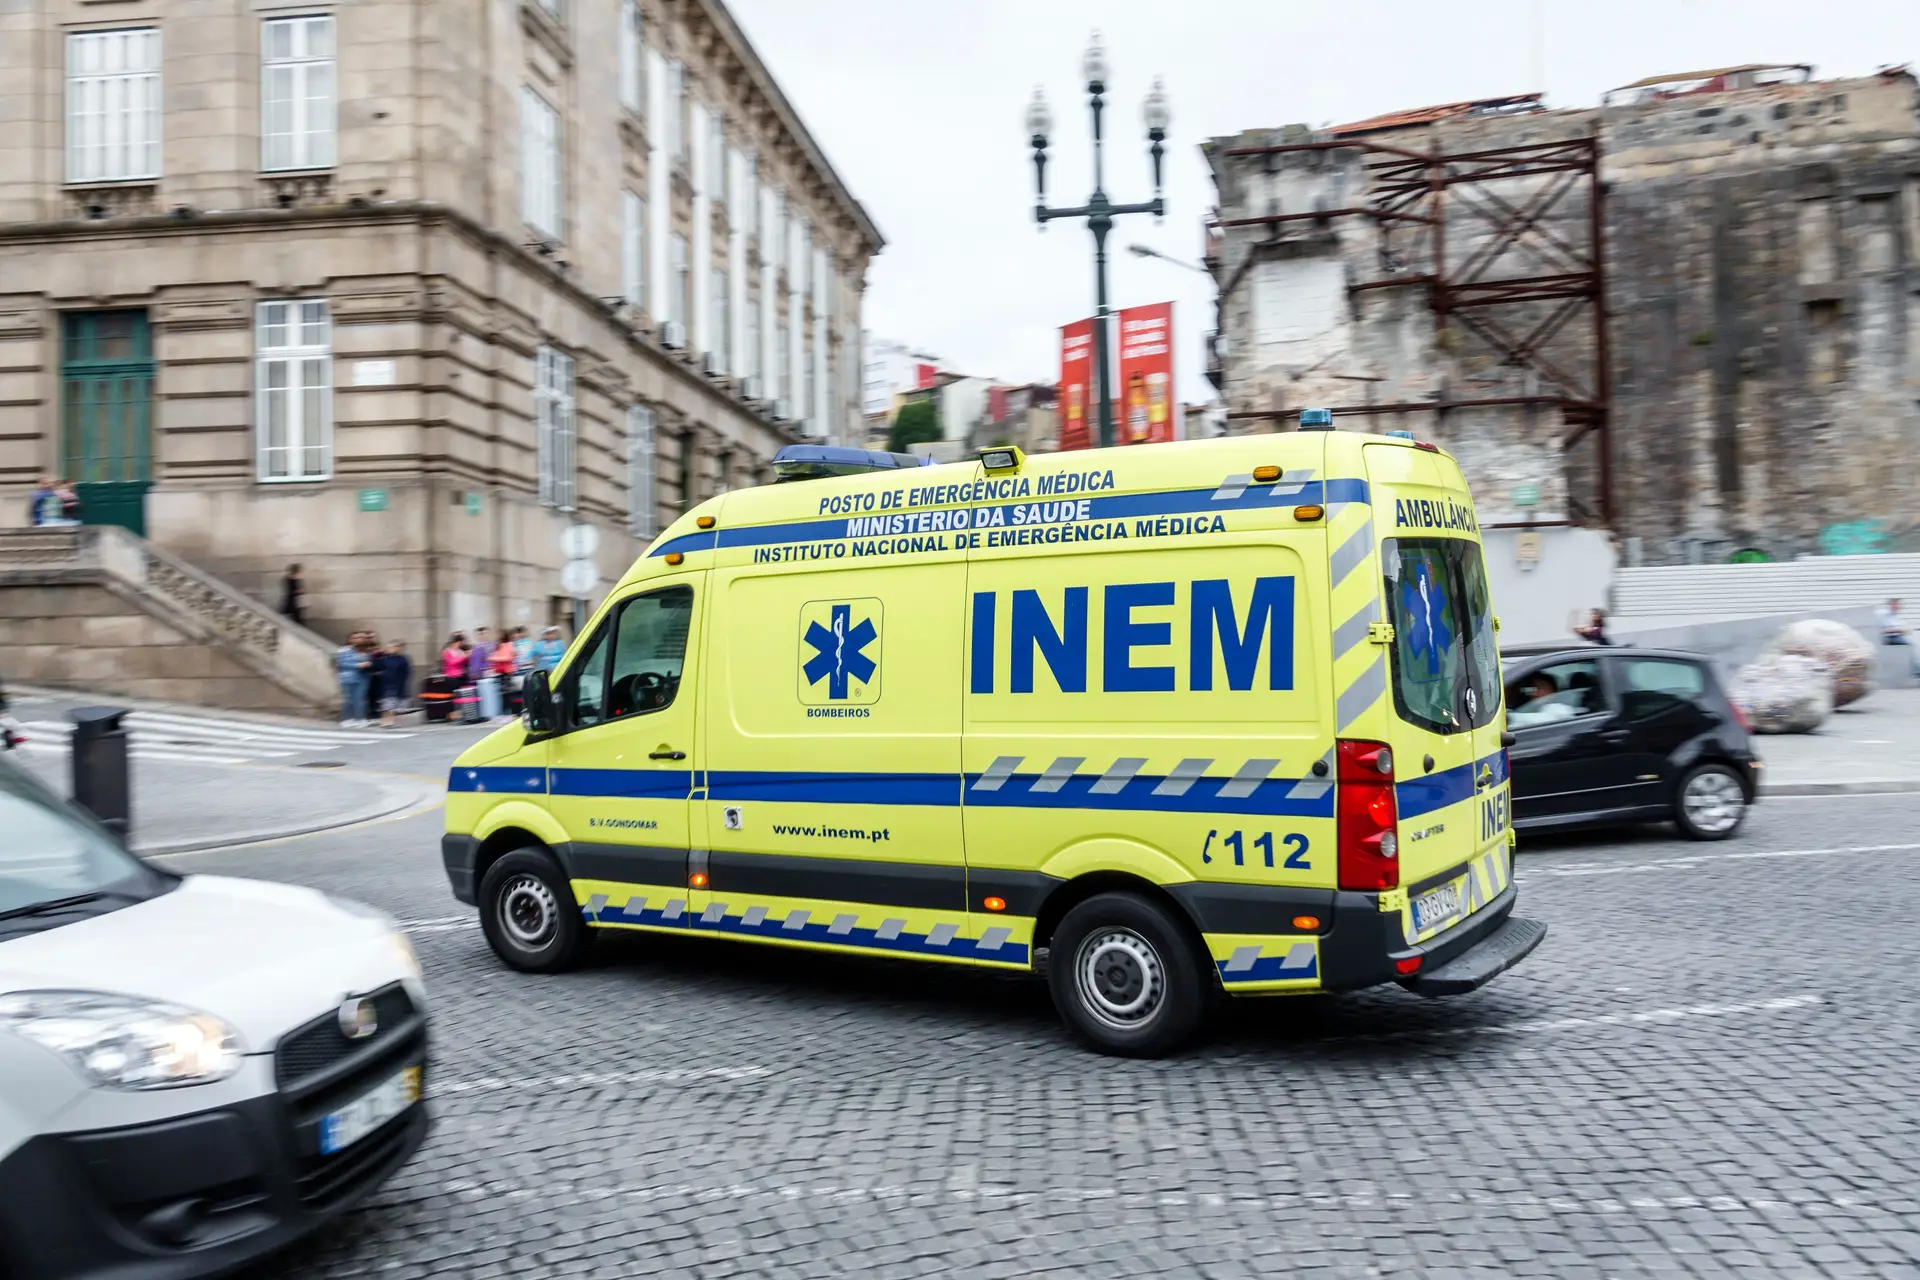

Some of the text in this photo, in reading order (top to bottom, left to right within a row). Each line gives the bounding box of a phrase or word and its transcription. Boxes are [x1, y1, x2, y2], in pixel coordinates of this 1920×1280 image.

[818, 470, 1115, 516] POSTO DE EMERGÊNCIA MÉDICA
[975, 506, 1005, 528] DA
[753, 515, 1227, 563] INSTITUTO NACIONAL DE EMERGÊNCIA MÉDICA
[970, 575, 1295, 694] INEM
[807, 708, 870, 718] BOMBEIROS
[772, 824, 890, 843] www.inem.pt
[1223, 829, 1312, 870] 112
